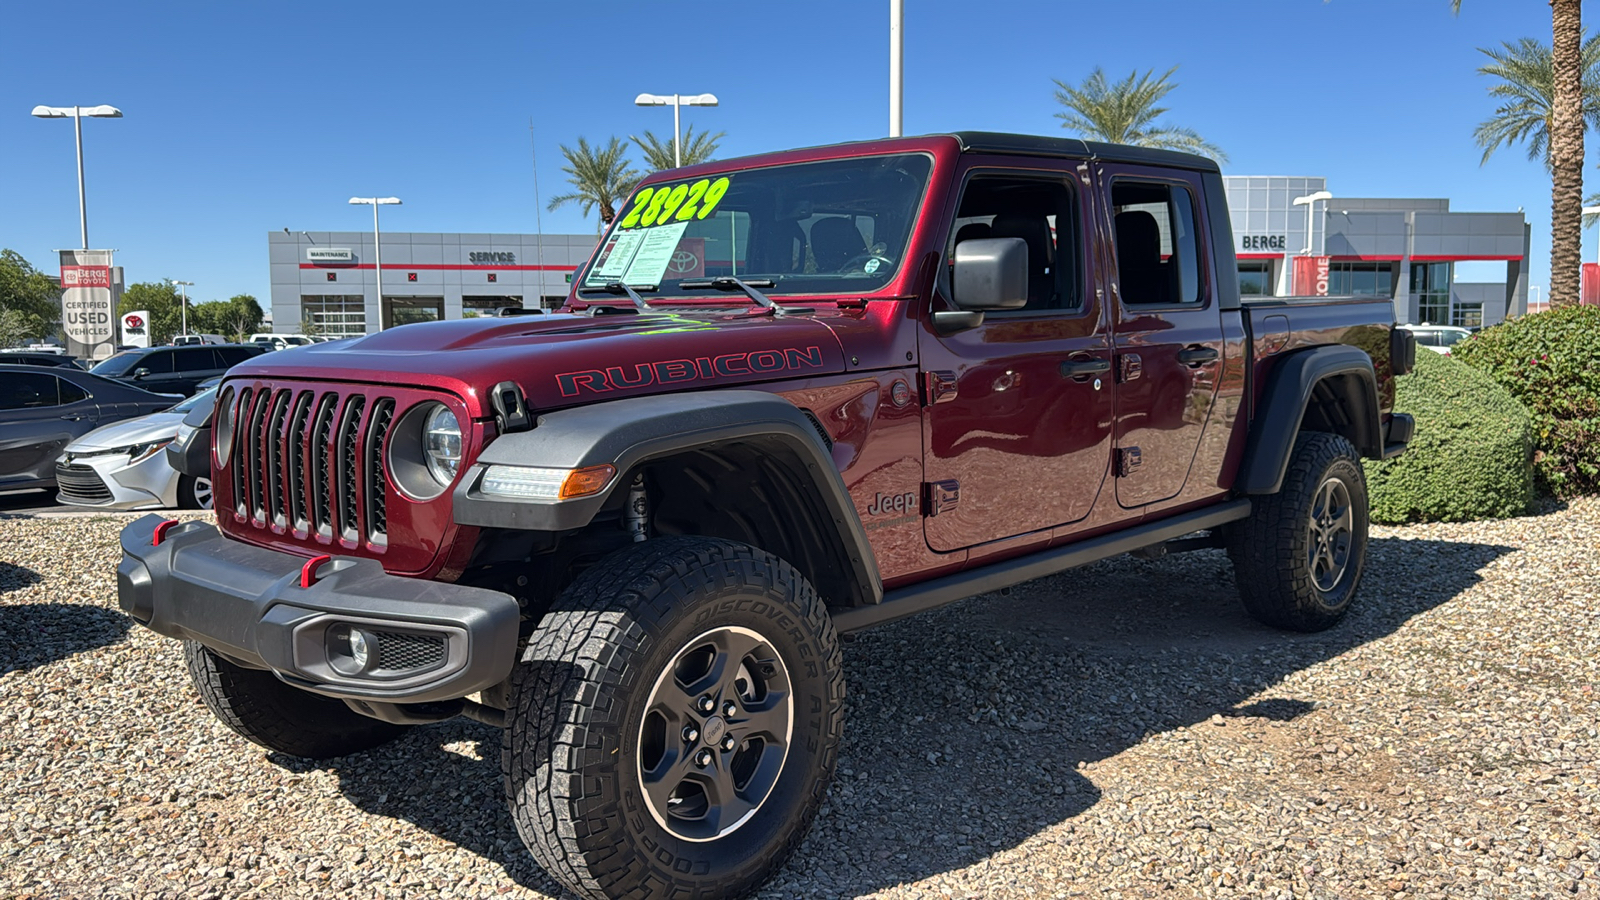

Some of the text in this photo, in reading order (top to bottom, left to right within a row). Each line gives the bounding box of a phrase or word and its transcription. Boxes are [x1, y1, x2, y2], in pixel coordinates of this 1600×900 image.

[622, 178, 730, 229] 28929
[1242, 235, 1285, 249] BERGE
[310, 251, 349, 259] MAINTENANCE
[469, 251, 514, 263] SERVICE
[78, 269, 107, 278] BERGE
[66, 301, 108, 309] CERTIFIED
[68, 312, 109, 325] USED
[68, 327, 108, 336] VEHICLES
[555, 347, 823, 397] RUBICON
[868, 492, 916, 515] Jeep
[694, 599, 819, 680] DISCOVERER
[624, 786, 710, 876] COOPER
